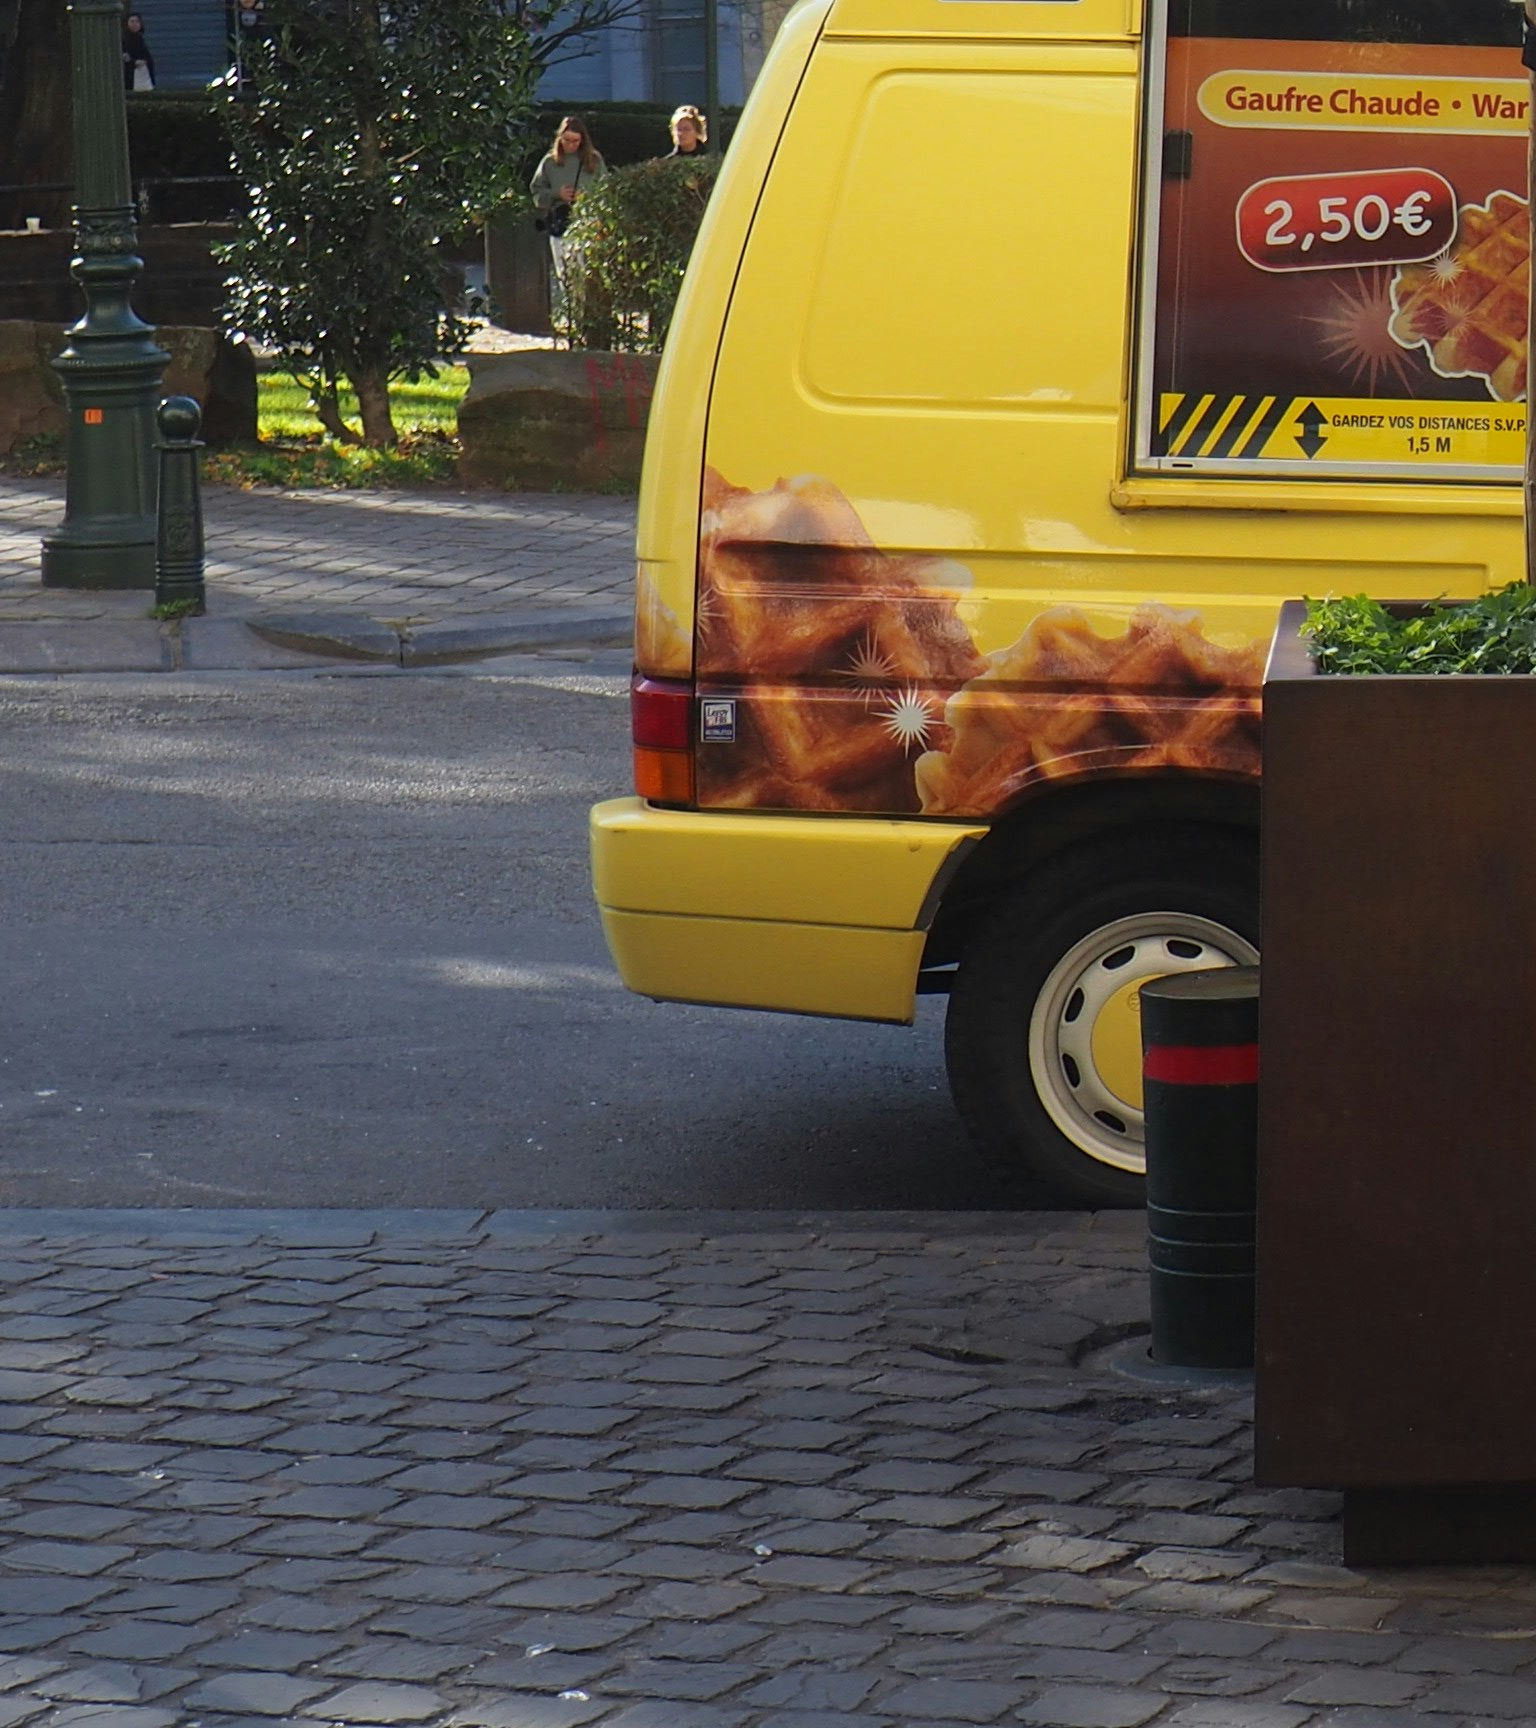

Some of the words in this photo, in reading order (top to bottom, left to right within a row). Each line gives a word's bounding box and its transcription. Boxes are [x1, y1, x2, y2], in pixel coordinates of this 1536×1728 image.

[1225, 86, 1323, 113] Gaufre
[1330, 88, 1440, 116] Chaude
[1264, 190, 1432, 252] 2,50€
[1332, 414, 1384, 428] GARDEZ
[1389, 416, 1414, 429] VOS
[1419, 417, 1490, 431] DISTANCES
[1494, 419, 1527, 432] S.V.P.
[1407, 437, 1430, 455] 1,5
[1436, 437, 1450, 452] M
